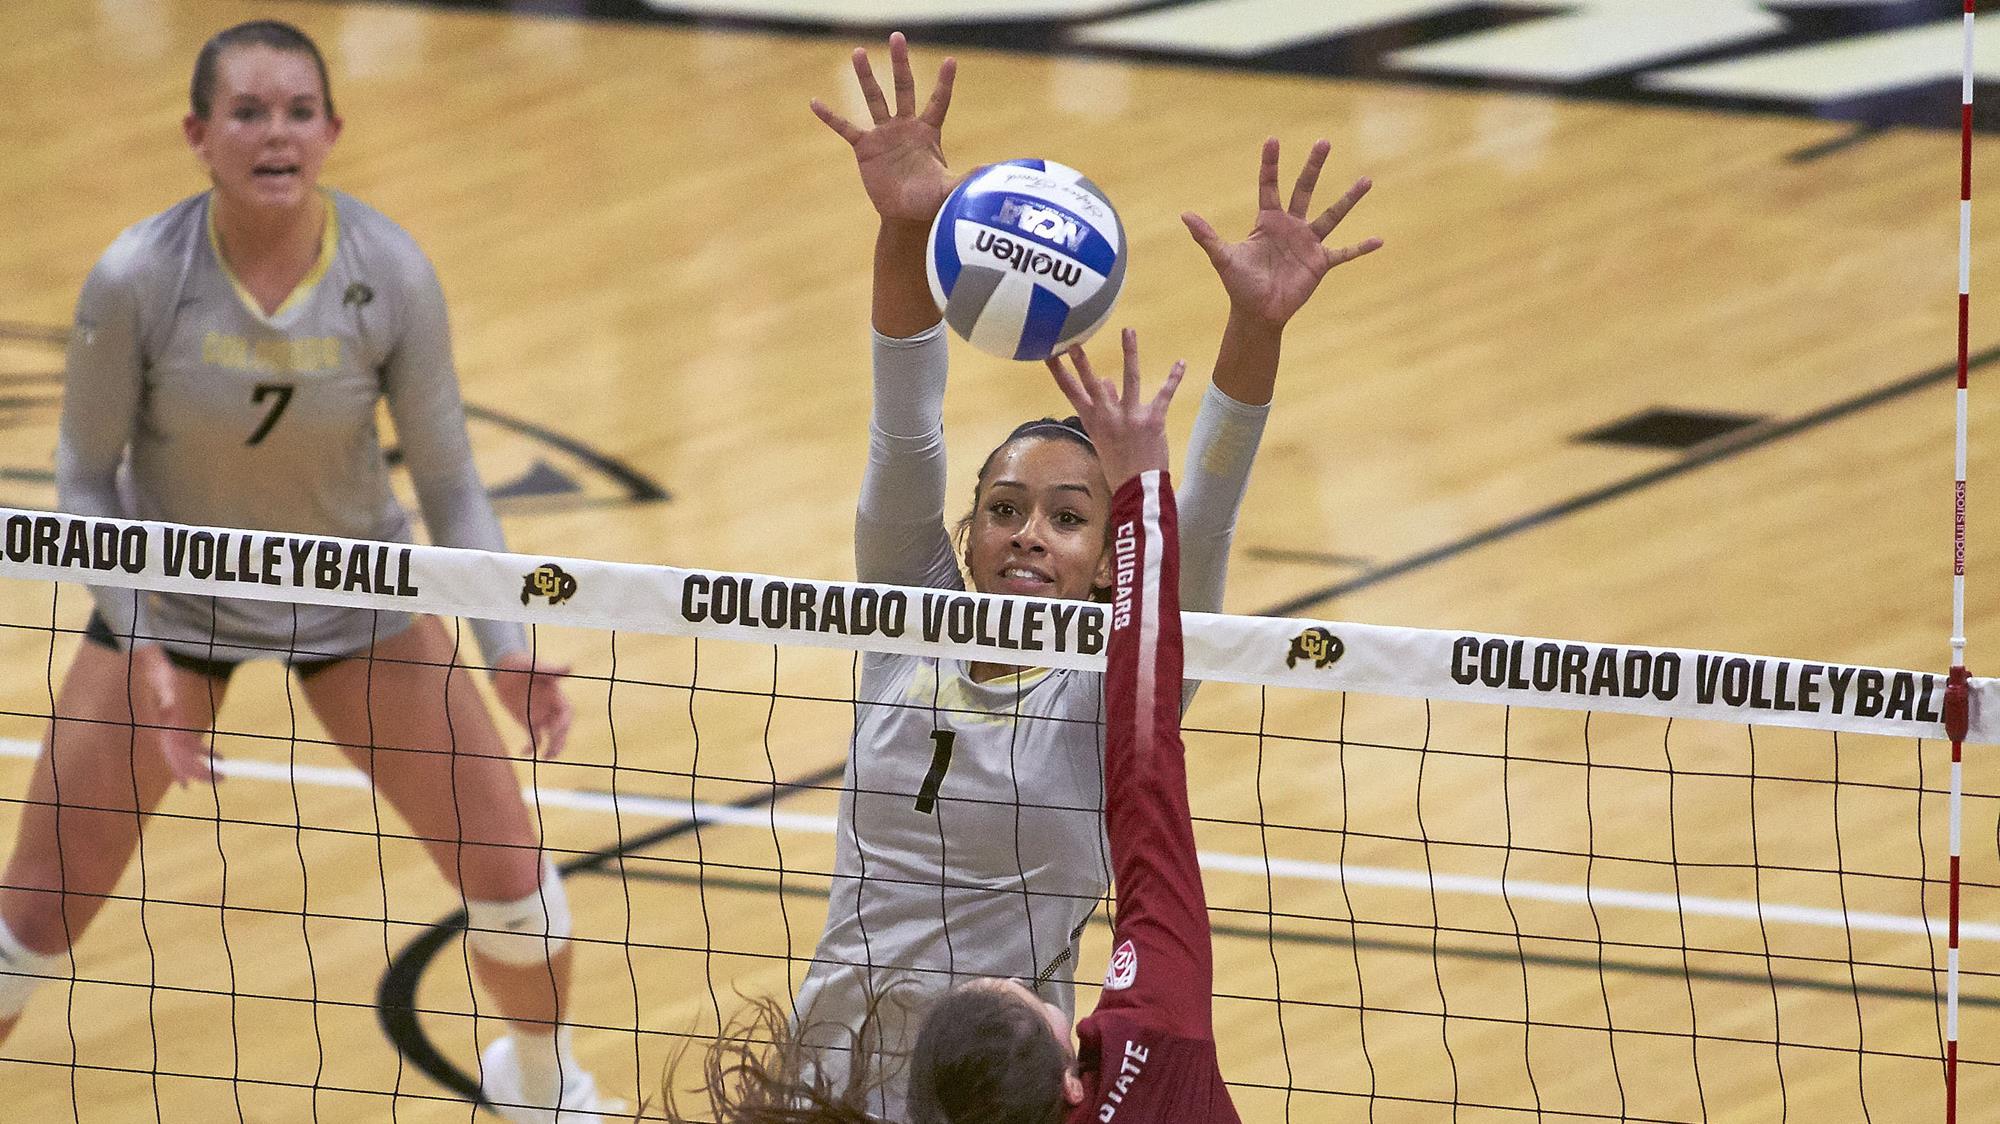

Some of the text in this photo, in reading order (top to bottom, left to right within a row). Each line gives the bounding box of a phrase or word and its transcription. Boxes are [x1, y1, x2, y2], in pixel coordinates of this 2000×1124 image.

[975, 230, 1082, 287] molten
[999, 196, 1089, 251] NCAA
[246, 383, 294, 446] 7
[0, 515, 418, 597] ORADO VOLLEYBALL
[1114, 521, 1136, 630] COUGARS
[681, 574, 1105, 656] COLORADO VOLLEYB
[1451, 636, 1947, 723] COLORADO VOLLEYBAL
[914, 730, 956, 815] 1
